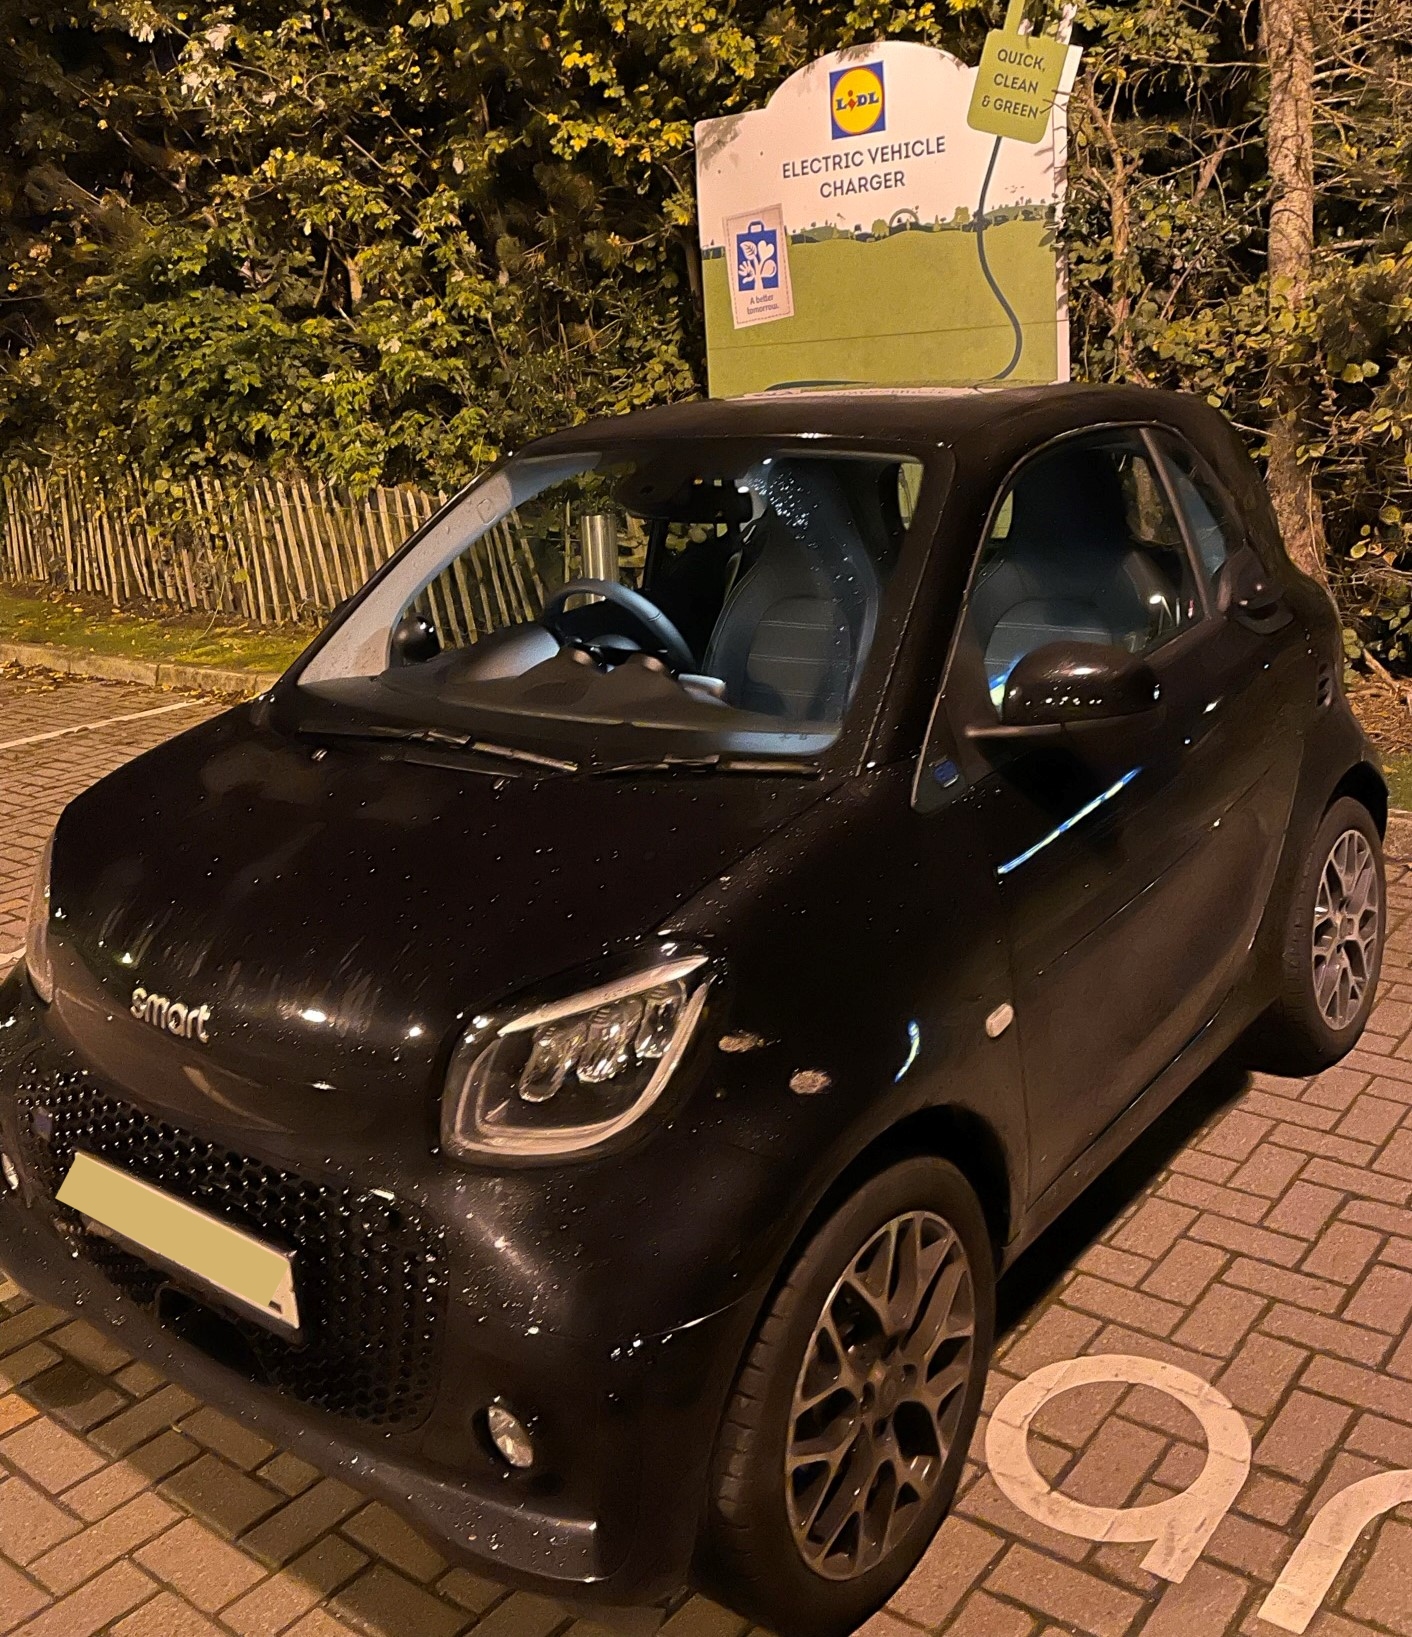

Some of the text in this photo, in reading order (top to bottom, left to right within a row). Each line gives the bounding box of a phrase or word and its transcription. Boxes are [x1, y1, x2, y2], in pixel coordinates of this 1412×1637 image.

[997, 49, 1046, 72] QUICK,
[993, 73, 1039, 95] CLEAN
[981, 95, 1039, 119] & GREEN
[782, 135, 946, 179] ELECTRIC VEHICLE
[820, 170, 905, 198] CHARGER
[746, 303, 780, 315] tomorrow.
[749, 294, 774, 305] A better
[130, 987, 211, 1043] smart
